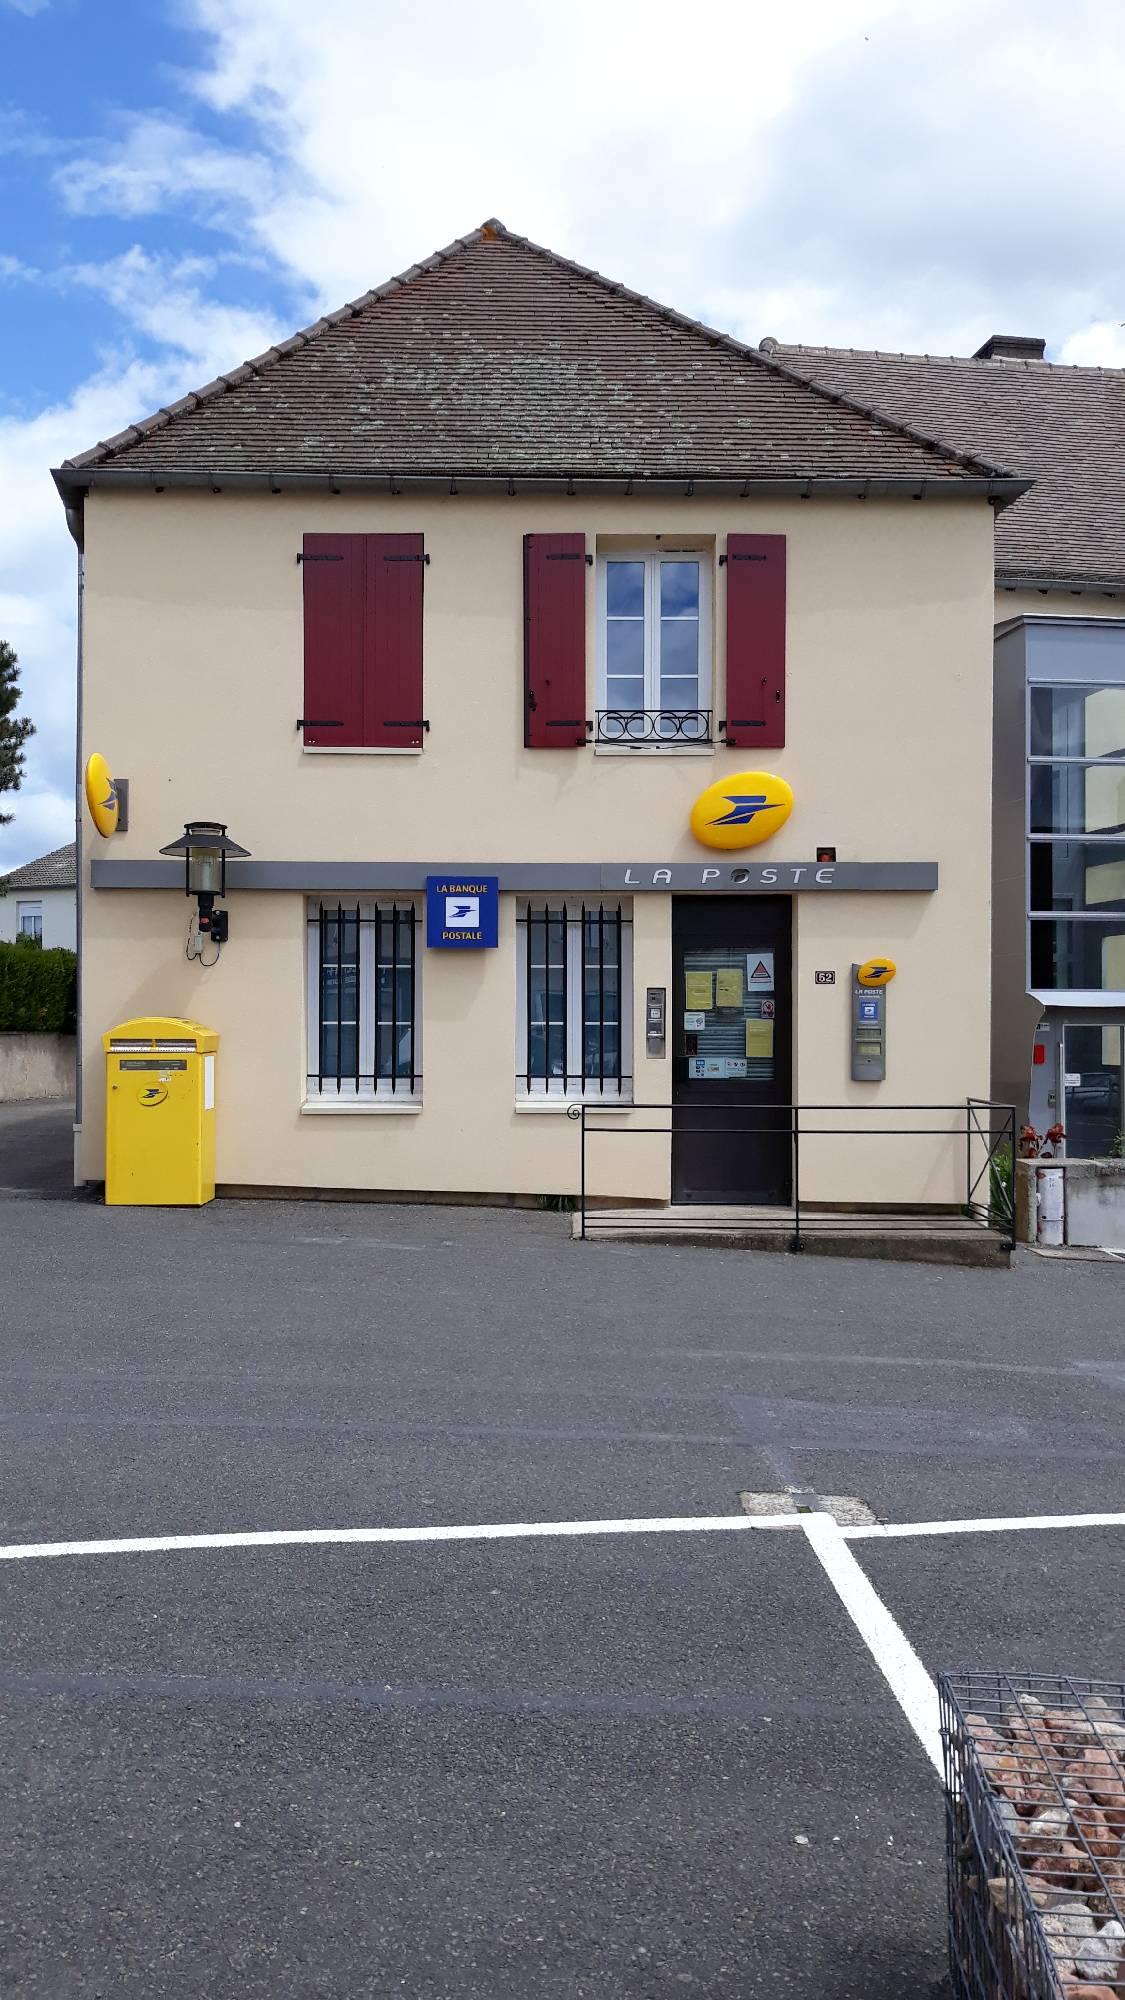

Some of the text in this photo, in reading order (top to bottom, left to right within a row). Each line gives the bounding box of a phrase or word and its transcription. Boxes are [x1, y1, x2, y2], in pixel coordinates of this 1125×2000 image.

[623, 868, 836, 884] LA POSTE
[436, 884, 488, 895] LA BANQUE
[442, 931, 483, 940] POSTALE
